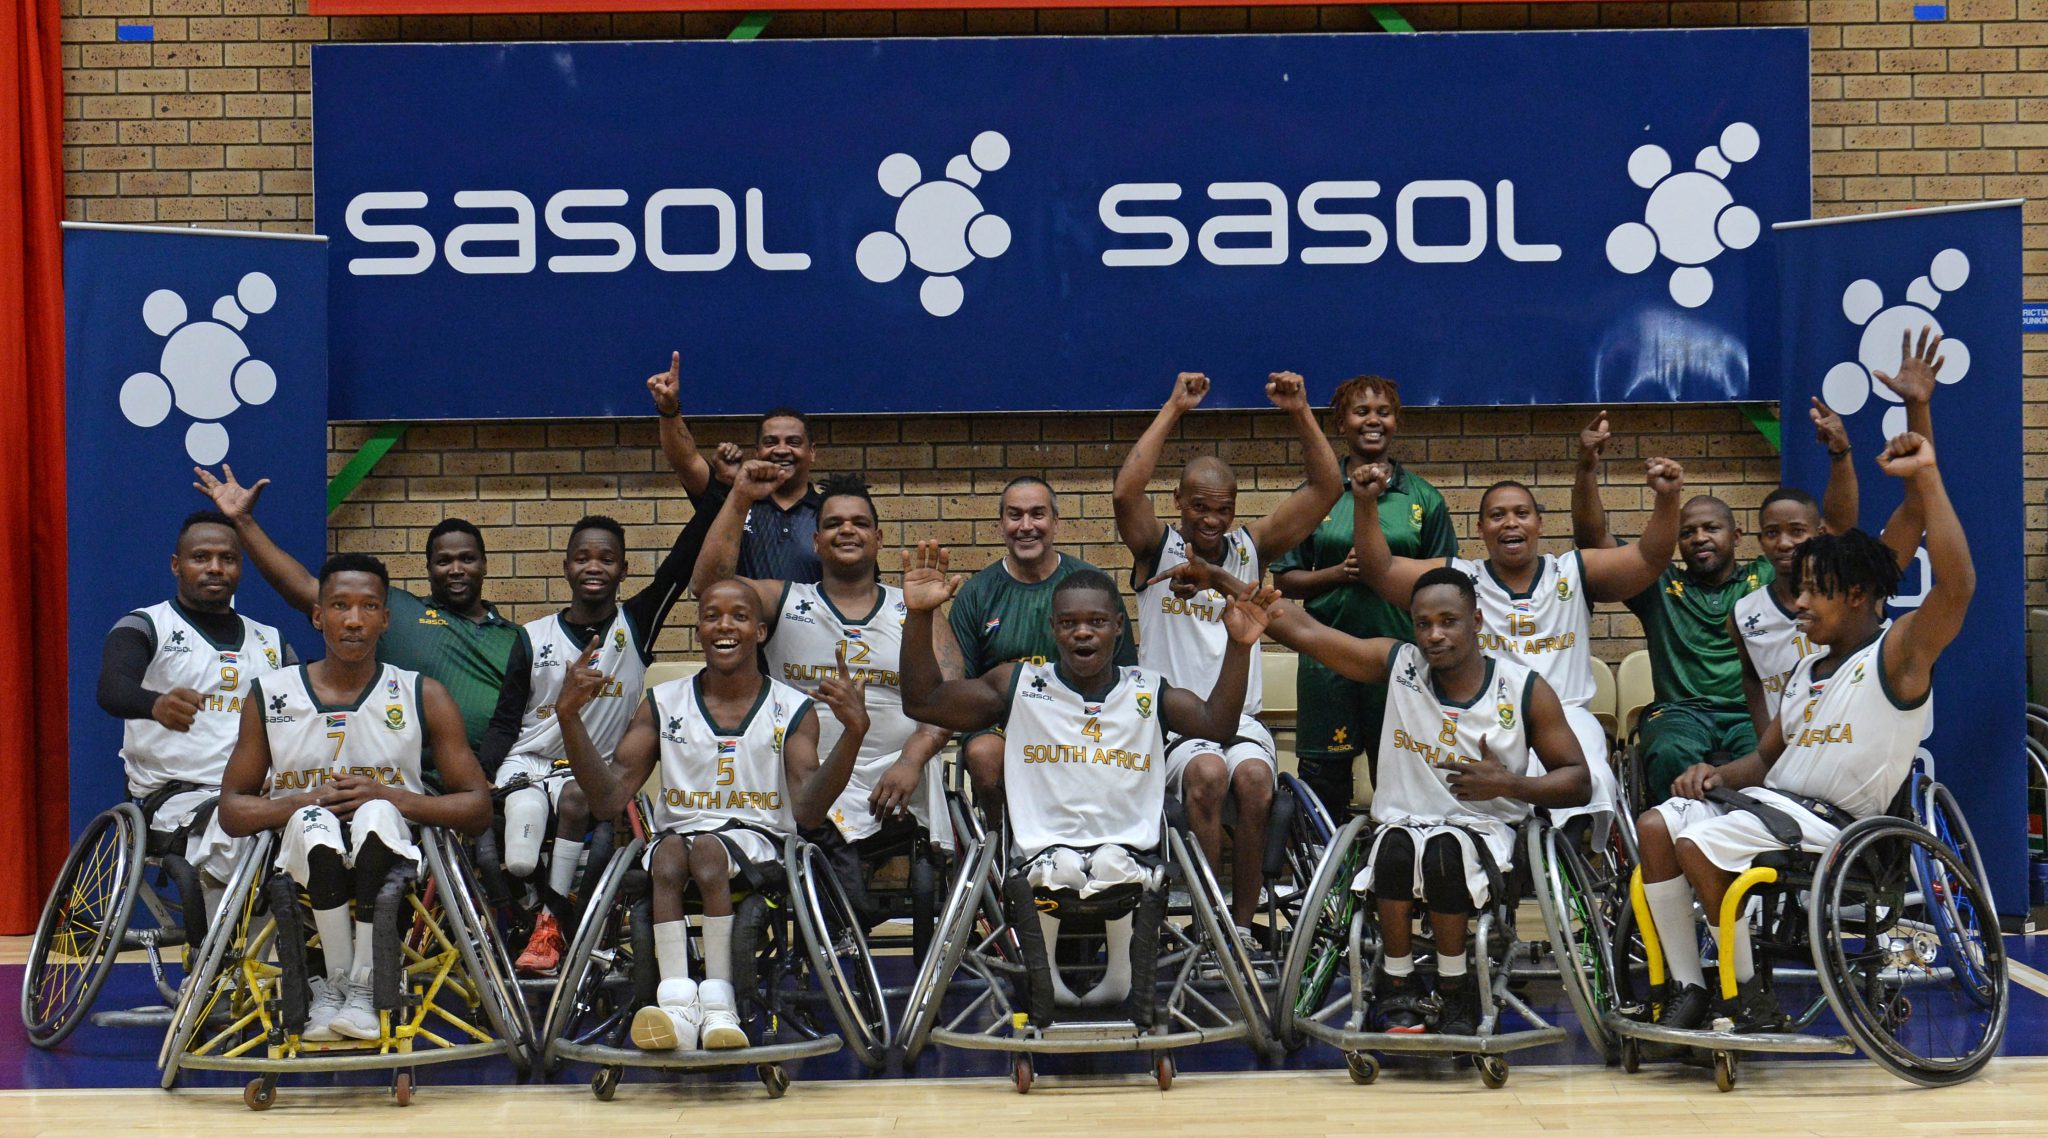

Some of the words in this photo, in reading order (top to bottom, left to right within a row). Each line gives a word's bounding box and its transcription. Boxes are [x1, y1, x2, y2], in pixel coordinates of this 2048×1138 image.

[1506, 613, 1537, 637] 15
[835, 639, 871, 665] 12
[1475, 633, 1519, 653] OUTH
[219, 666, 239, 692] 9
[1081, 716, 1103, 743] 4
[1438, 718, 1458, 747] 8
[326, 731, 346, 762] 7
[1023, 744, 1087, 764] SOUTH
[1092, 748, 1151, 773] AFRICA
[274, 766, 334, 791] SOUTH
[716, 756, 736, 786] 5
